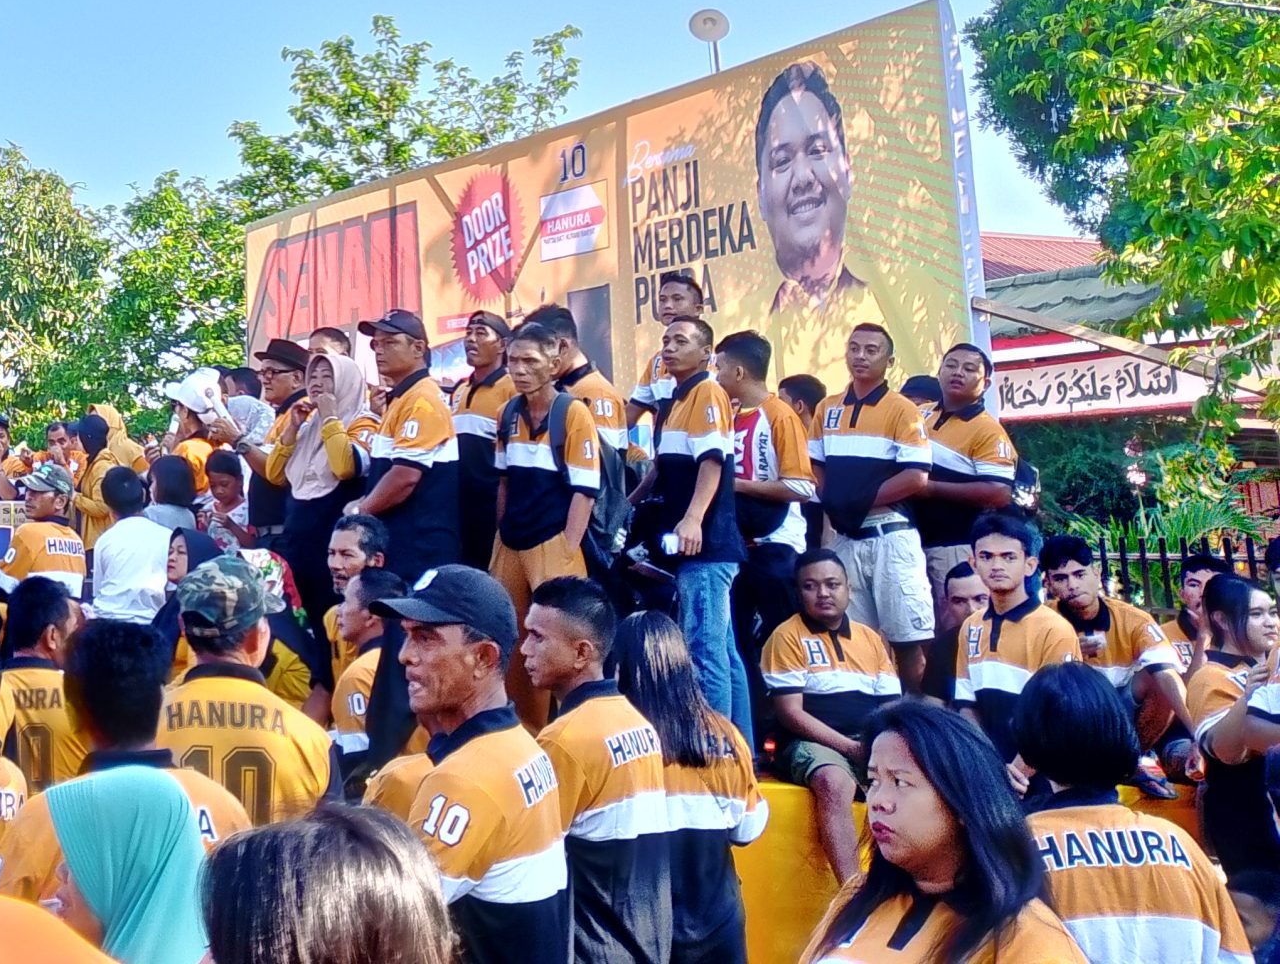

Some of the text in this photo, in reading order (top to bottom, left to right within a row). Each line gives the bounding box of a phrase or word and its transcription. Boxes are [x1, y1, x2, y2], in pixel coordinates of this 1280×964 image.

[559, 143, 587, 184] 10
[632, 160, 700, 223] PANJI
[461, 191, 507, 249] DOOR
[546, 211, 592, 234] HANURA
[633, 200, 756, 274] MERDEKA
[265, 210, 420, 341] SENAM
[466, 225, 514, 285] PRIZE
[635, 264, 717, 325] PUA
[595, 398, 613, 417] 10
[824, 406, 843, 431] H
[46, 537, 86, 557] HANUR
[801, 638, 831, 668] H
[166, 700, 287, 736] HANURA
[422, 794, 471, 847] 10
[1036, 828, 1192, 871] HANURA
